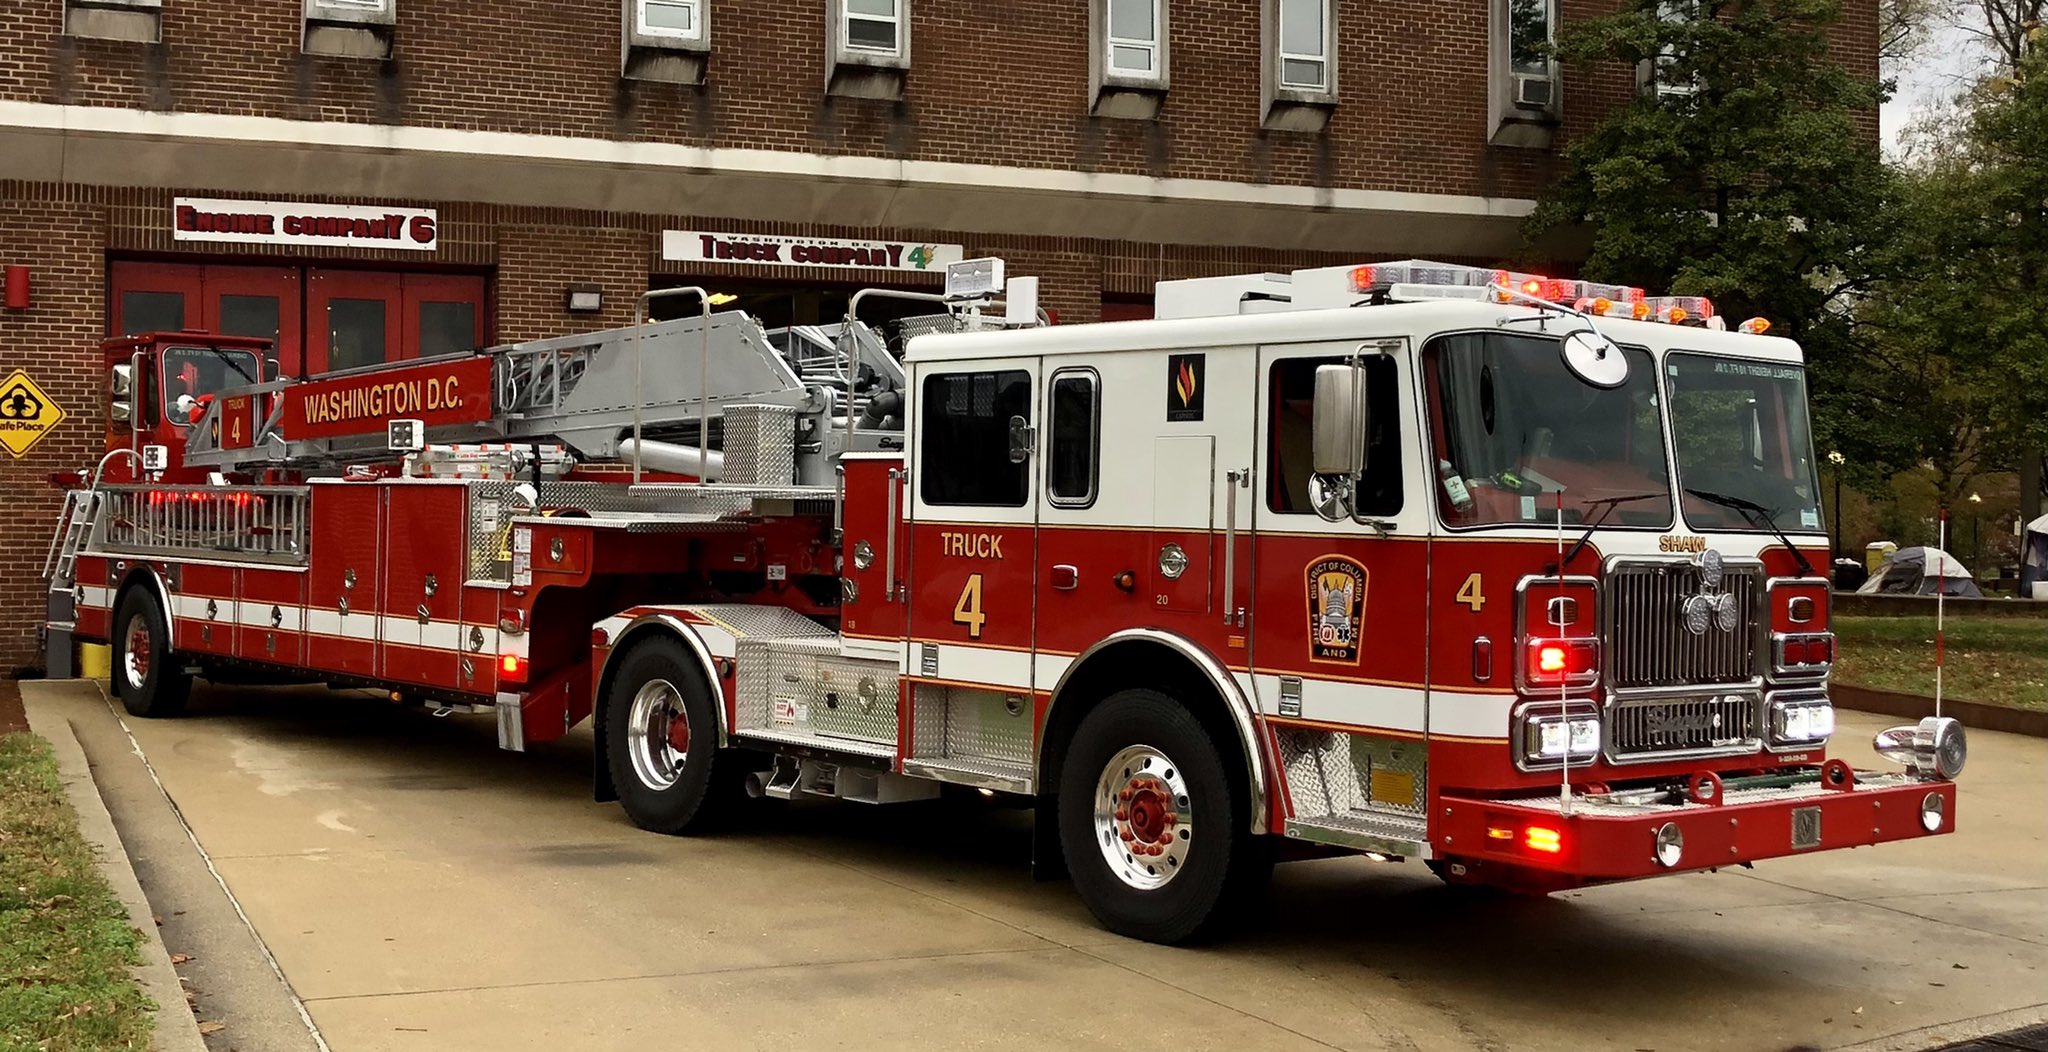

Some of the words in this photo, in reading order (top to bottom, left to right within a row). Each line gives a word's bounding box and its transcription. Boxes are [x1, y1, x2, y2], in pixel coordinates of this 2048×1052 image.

[409, 216, 435, 244] 6
[699, 235, 781, 262] TRUCK
[907, 247, 926, 269] 4
[228, 398, 245, 410] TRUCK
[304, 380, 421, 424] WASHINGTON
[427, 374, 463, 409] D.C.
[0, 421, 15, 431] afe
[17, 421, 44, 431] Place
[231, 416, 240, 443] 4
[941, 532, 1003, 559] TRUCK
[1659, 534, 1706, 553] SHAW
[1310, 563, 1328, 600] DISTRICT
[1328, 562, 1339, 570] OF
[1340, 563, 1363, 602] COLUMBIA
[1455, 572, 1486, 612] 4
[953, 573, 986, 638] 4
[1156, 594, 1168, 605] 20
[1322, 648, 1347, 658] AND
